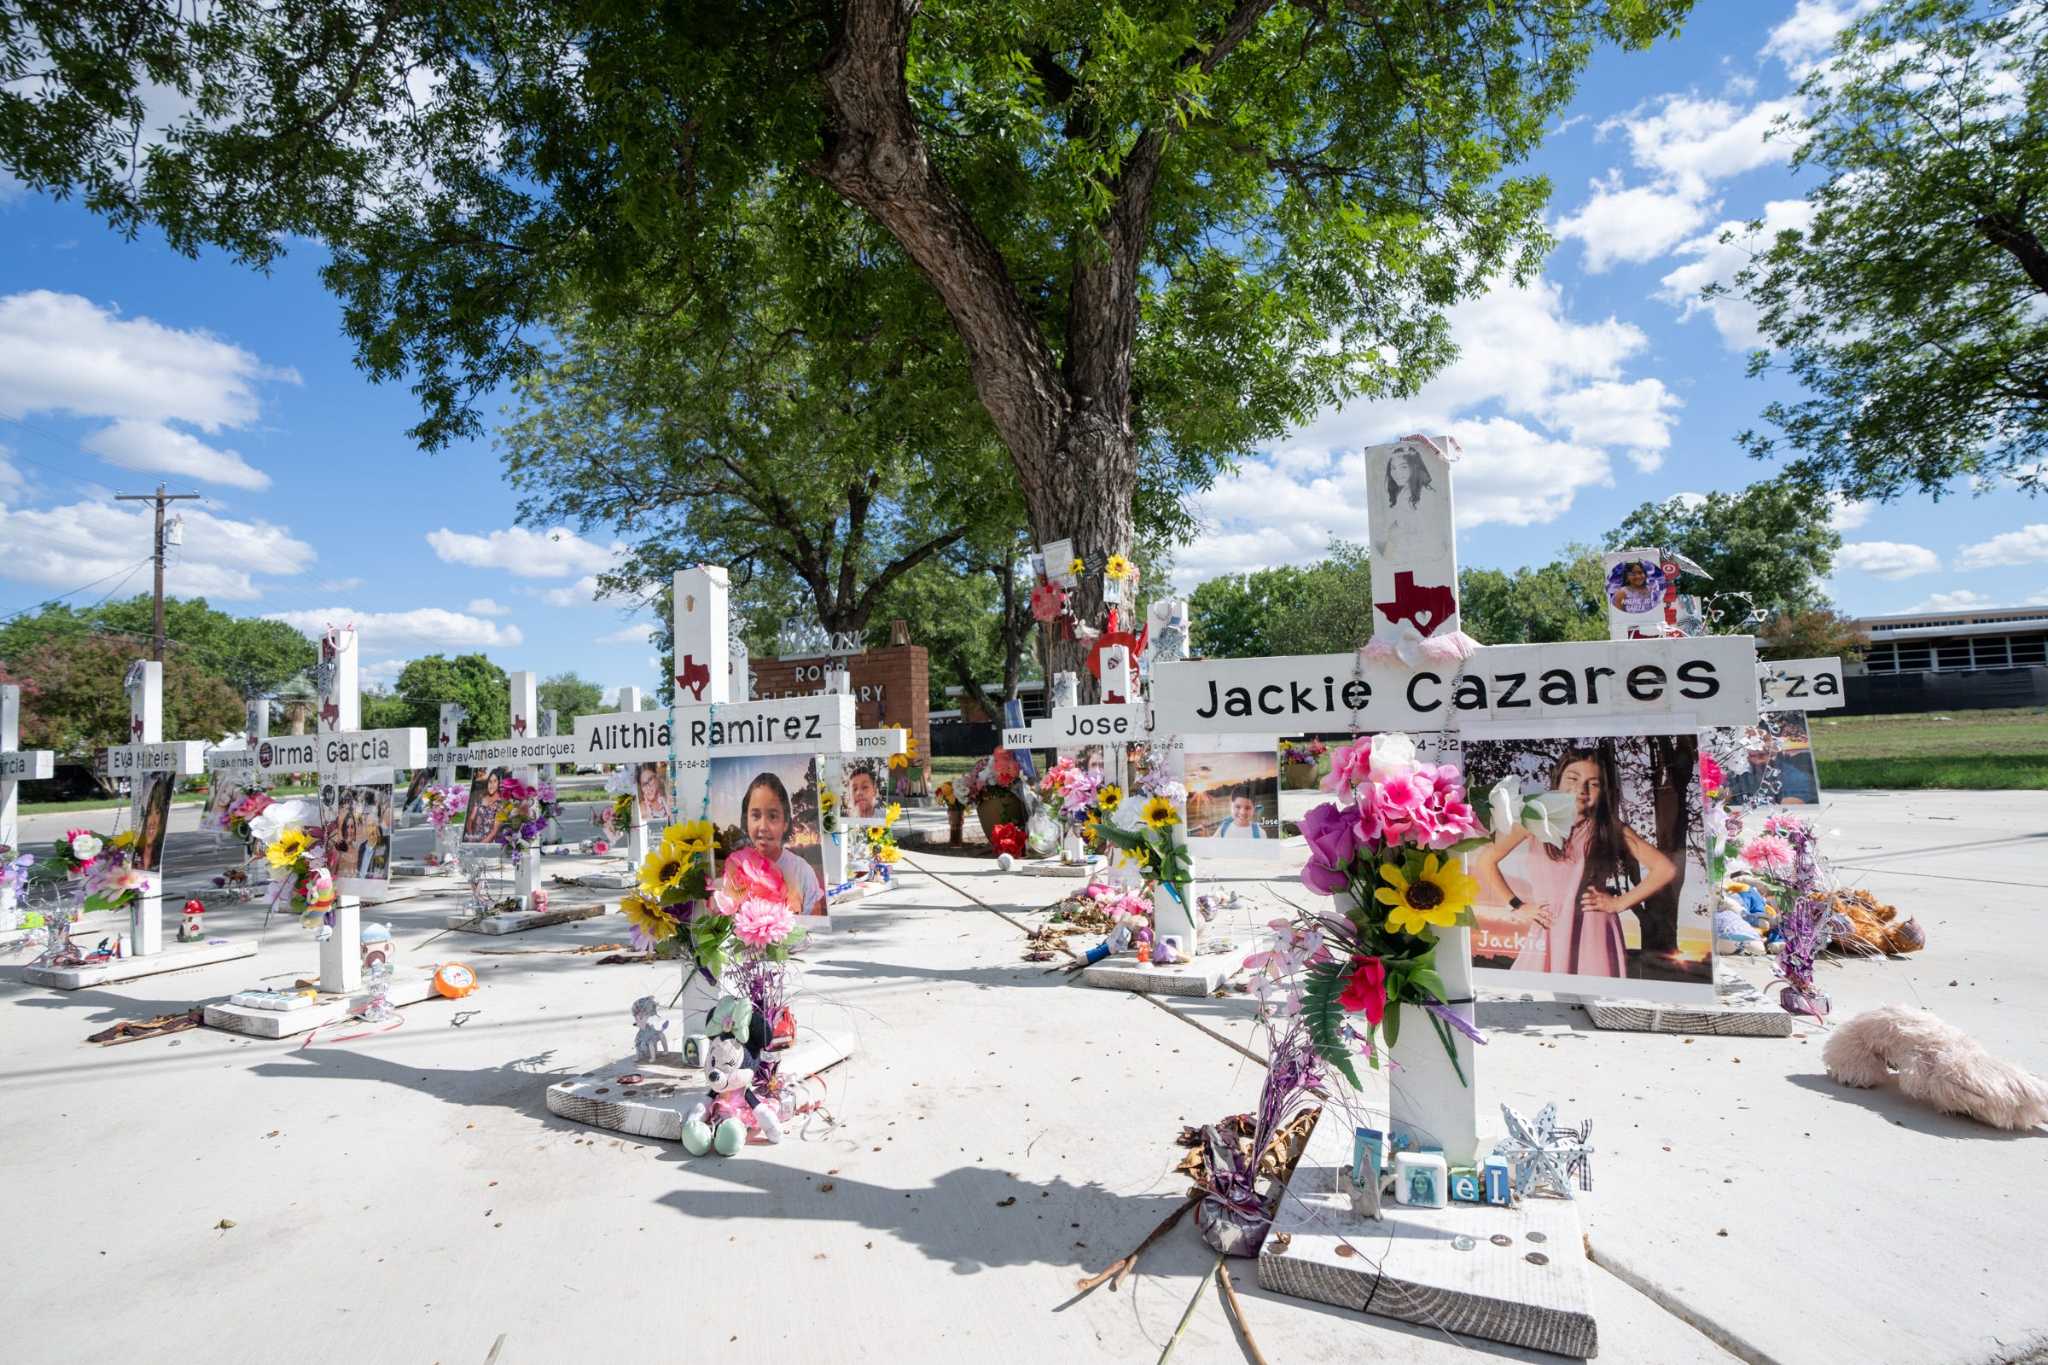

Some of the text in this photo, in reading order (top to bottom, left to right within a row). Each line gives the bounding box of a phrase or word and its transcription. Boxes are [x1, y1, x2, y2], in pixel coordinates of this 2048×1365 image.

[1196, 660, 1720, 718] Jackie Cazares
[590, 714, 822, 752] Alithia Ramirez
[1066, 714, 1128, 736] Jose
[114, 751, 133, 769] Eva
[274, 737, 389, 765] Irma Garcia
[468, 742, 575, 762] Annabelle Rodriguez
[1478, 929, 1546, 952] Jackie
